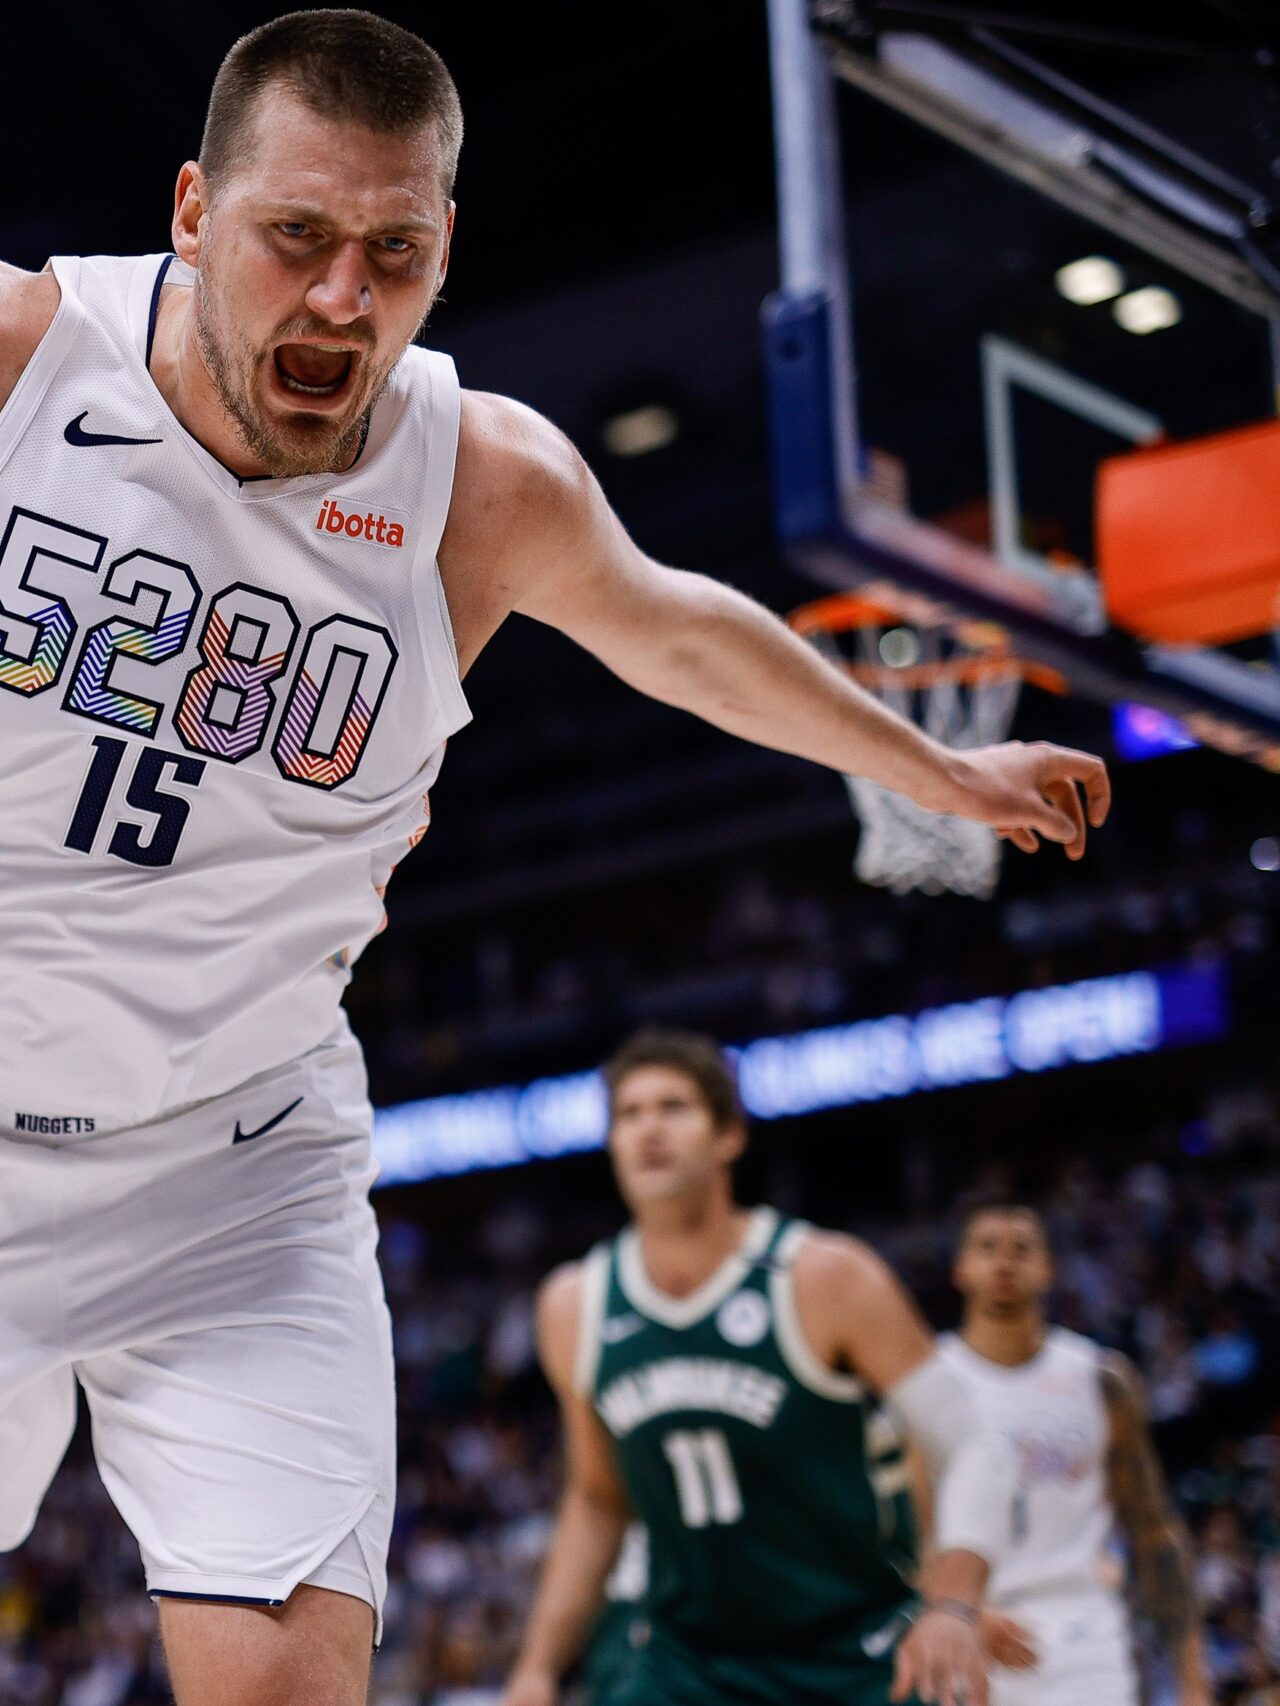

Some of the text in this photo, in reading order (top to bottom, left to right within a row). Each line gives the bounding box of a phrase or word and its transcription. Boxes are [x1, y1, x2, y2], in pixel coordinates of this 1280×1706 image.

[316, 500, 404, 547] ibotta
[63, 734, 208, 868] 15
[15, 1112, 95, 1135] NUGGETS
[663, 1427, 744, 1528] 11
